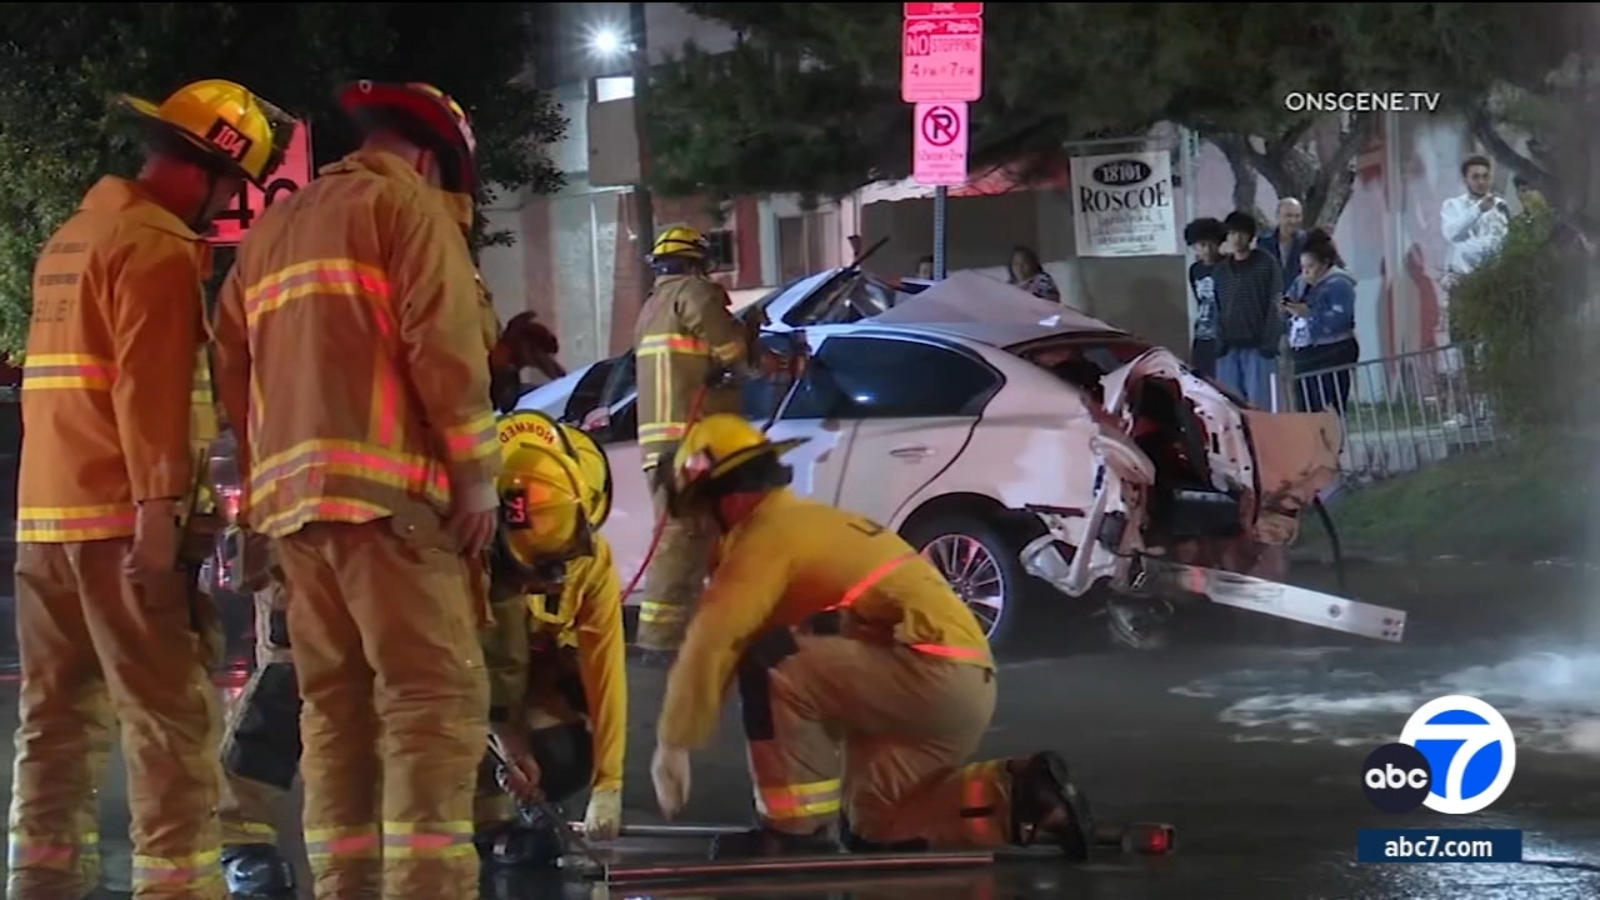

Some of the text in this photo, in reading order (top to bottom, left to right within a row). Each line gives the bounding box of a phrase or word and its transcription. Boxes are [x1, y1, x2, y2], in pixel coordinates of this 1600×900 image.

[906, 35, 977, 55] NO STOPPING
[213, 124, 247, 158] 104
[1101, 164, 1142, 182] 18101
[1080, 179, 1169, 213] ROSCOE
